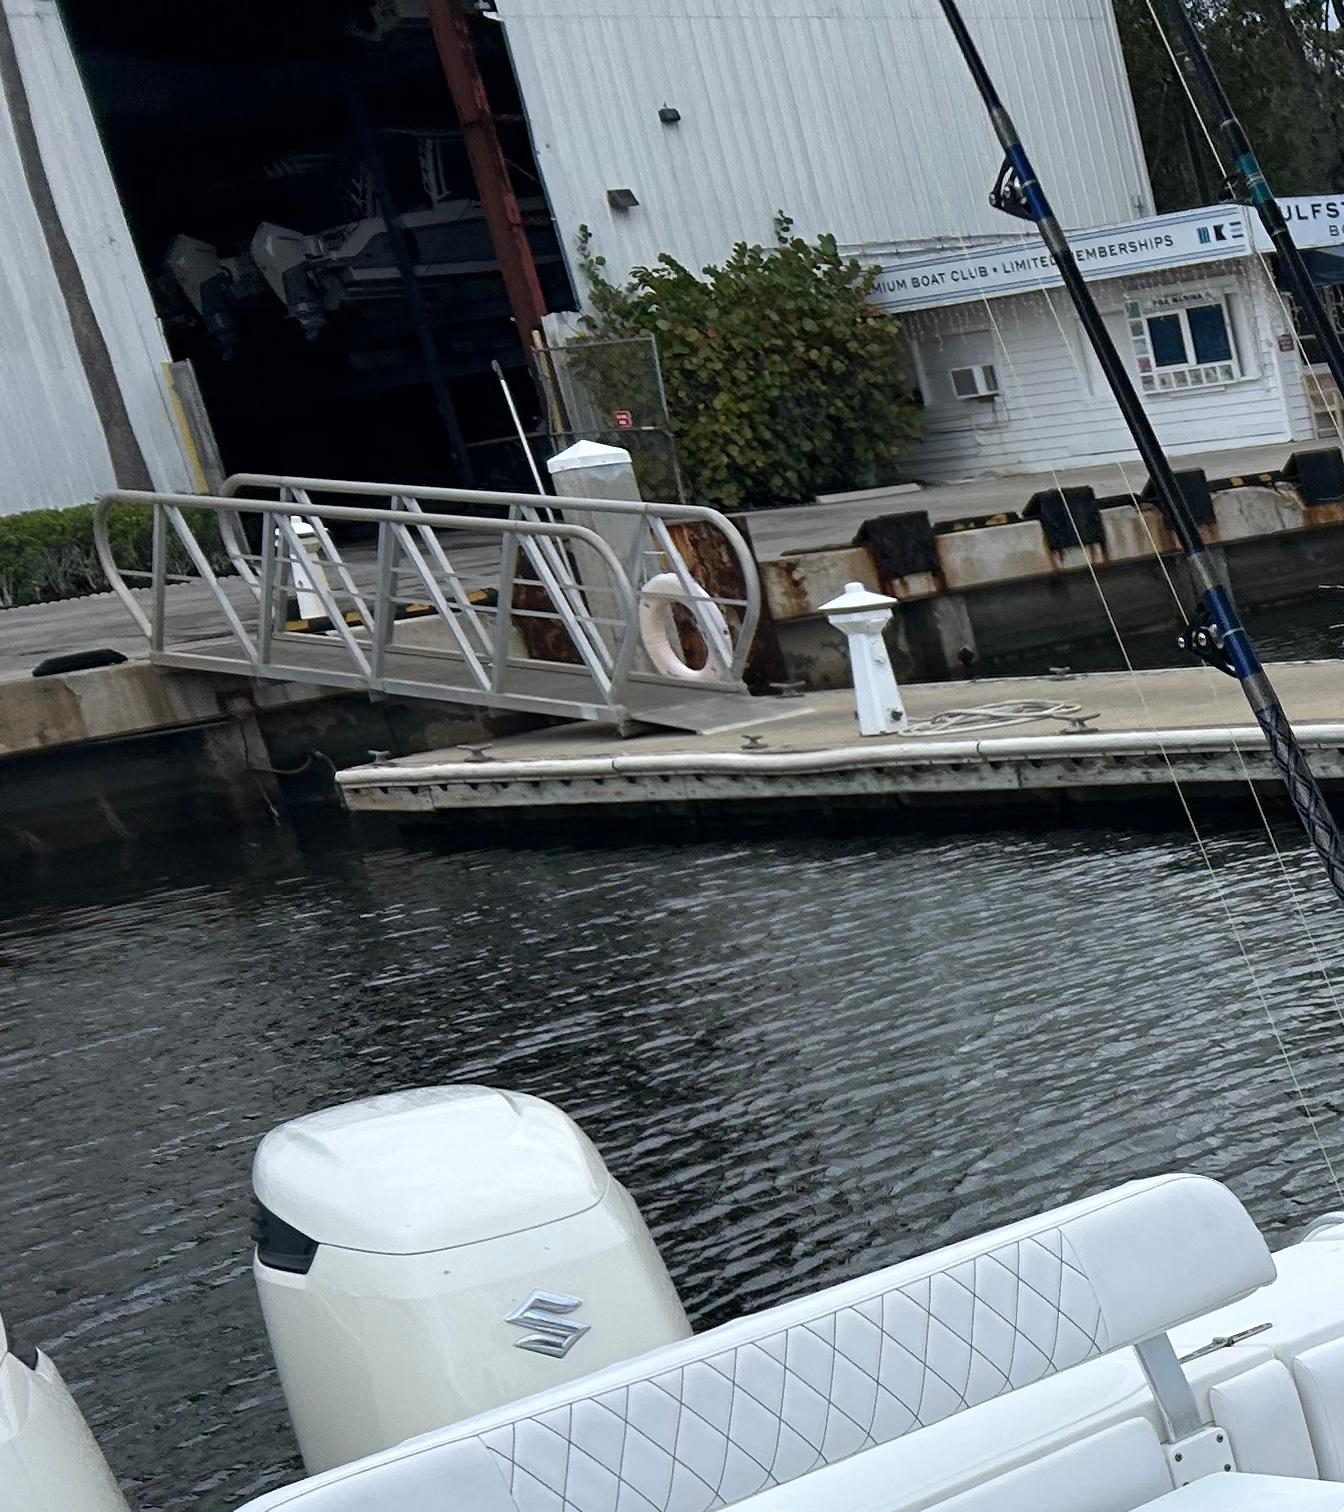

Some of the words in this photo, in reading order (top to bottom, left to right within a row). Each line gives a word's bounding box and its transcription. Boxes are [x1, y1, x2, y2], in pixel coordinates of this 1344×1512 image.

[871, 279, 908, 295] MIUM
[911, 272, 946, 289] BOAT
[950, 266, 988, 282] CLUB
[1075, 235, 1174, 262] EMBERSHIPS
